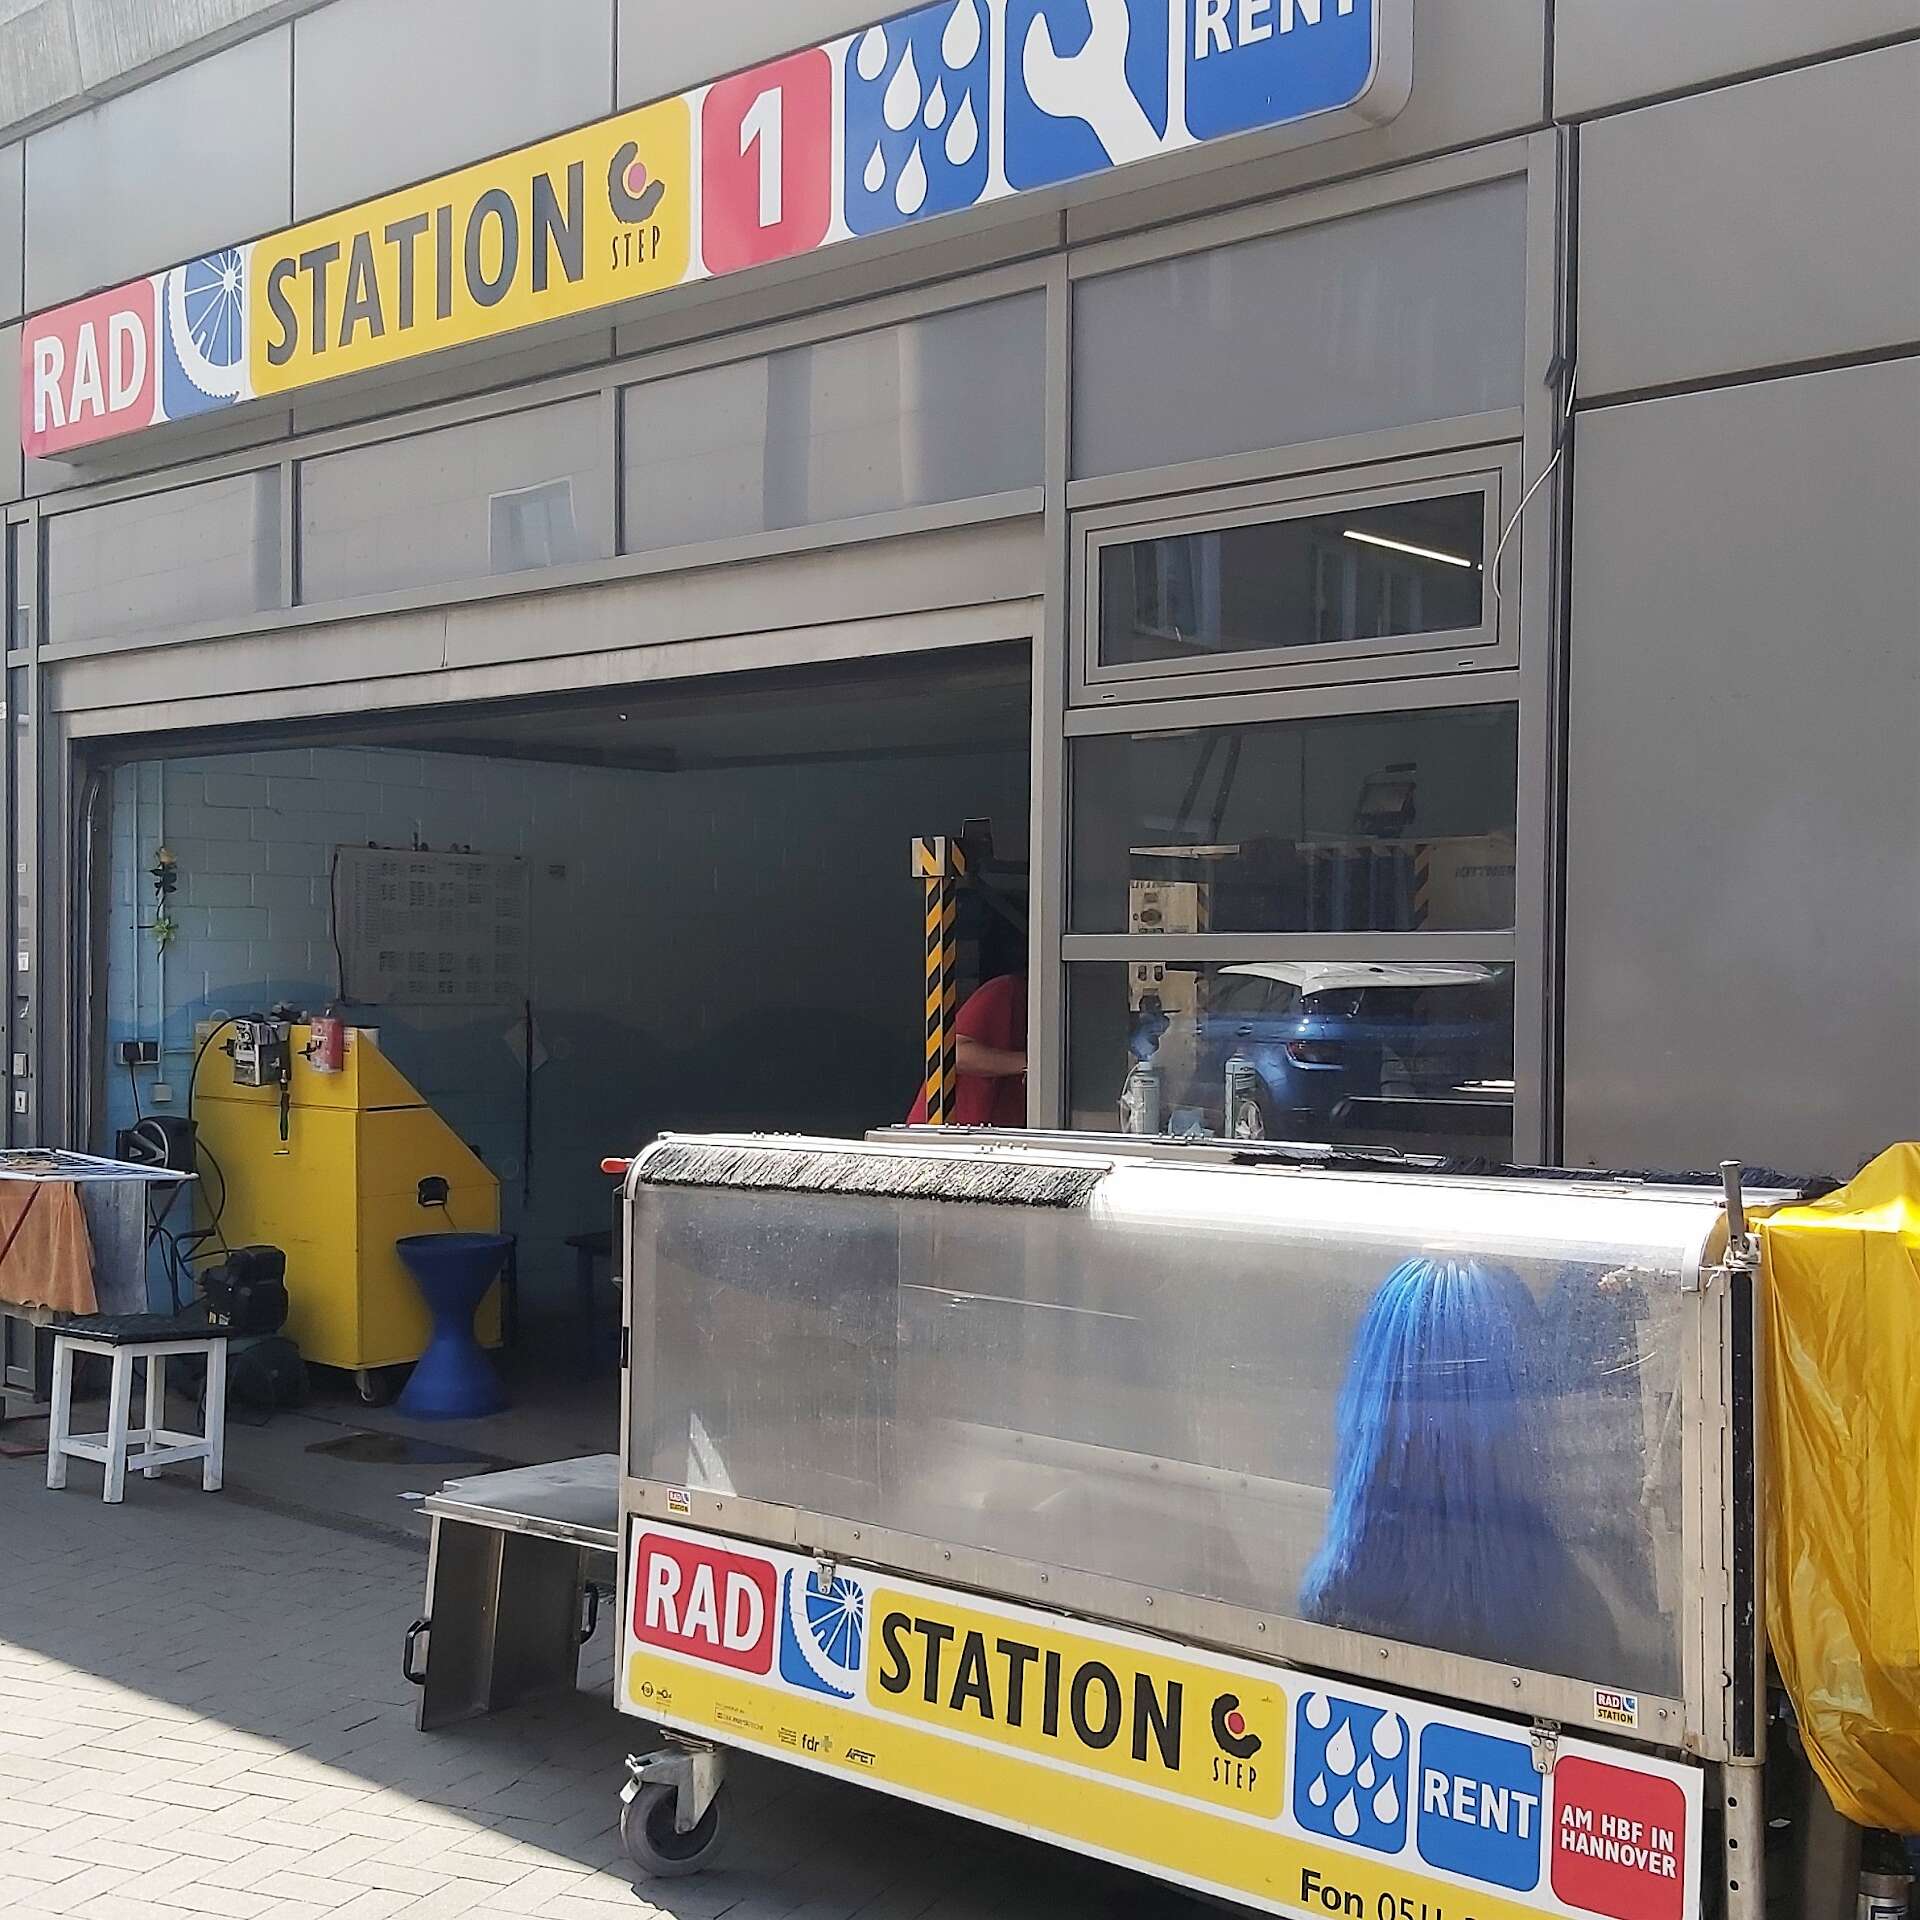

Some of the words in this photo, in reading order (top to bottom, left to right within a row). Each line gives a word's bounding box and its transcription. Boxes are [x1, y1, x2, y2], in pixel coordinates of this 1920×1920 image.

[739, 85, 783, 228] 1
[610, 225, 661, 272] STEP
[33, 310, 147, 432] RAD
[266, 161, 584, 366] STATION
[644, 1552, 765, 1650] RAD
[879, 1611, 1184, 1772] STATION
[1598, 1693, 1621, 1709] RAD
[1598, 1709, 1633, 1724] STATION
[1213, 1757, 1257, 1793] STEP
[1423, 1769, 1539, 1839] RENT
[1561, 1804, 1593, 1831] AM
[1602, 1813, 1643, 1844] HBF
[1651, 1826, 1674, 1853] IN
[1561, 1828, 1677, 1879] HANNOVER
[1300, 1867, 1364, 1919] Fon
